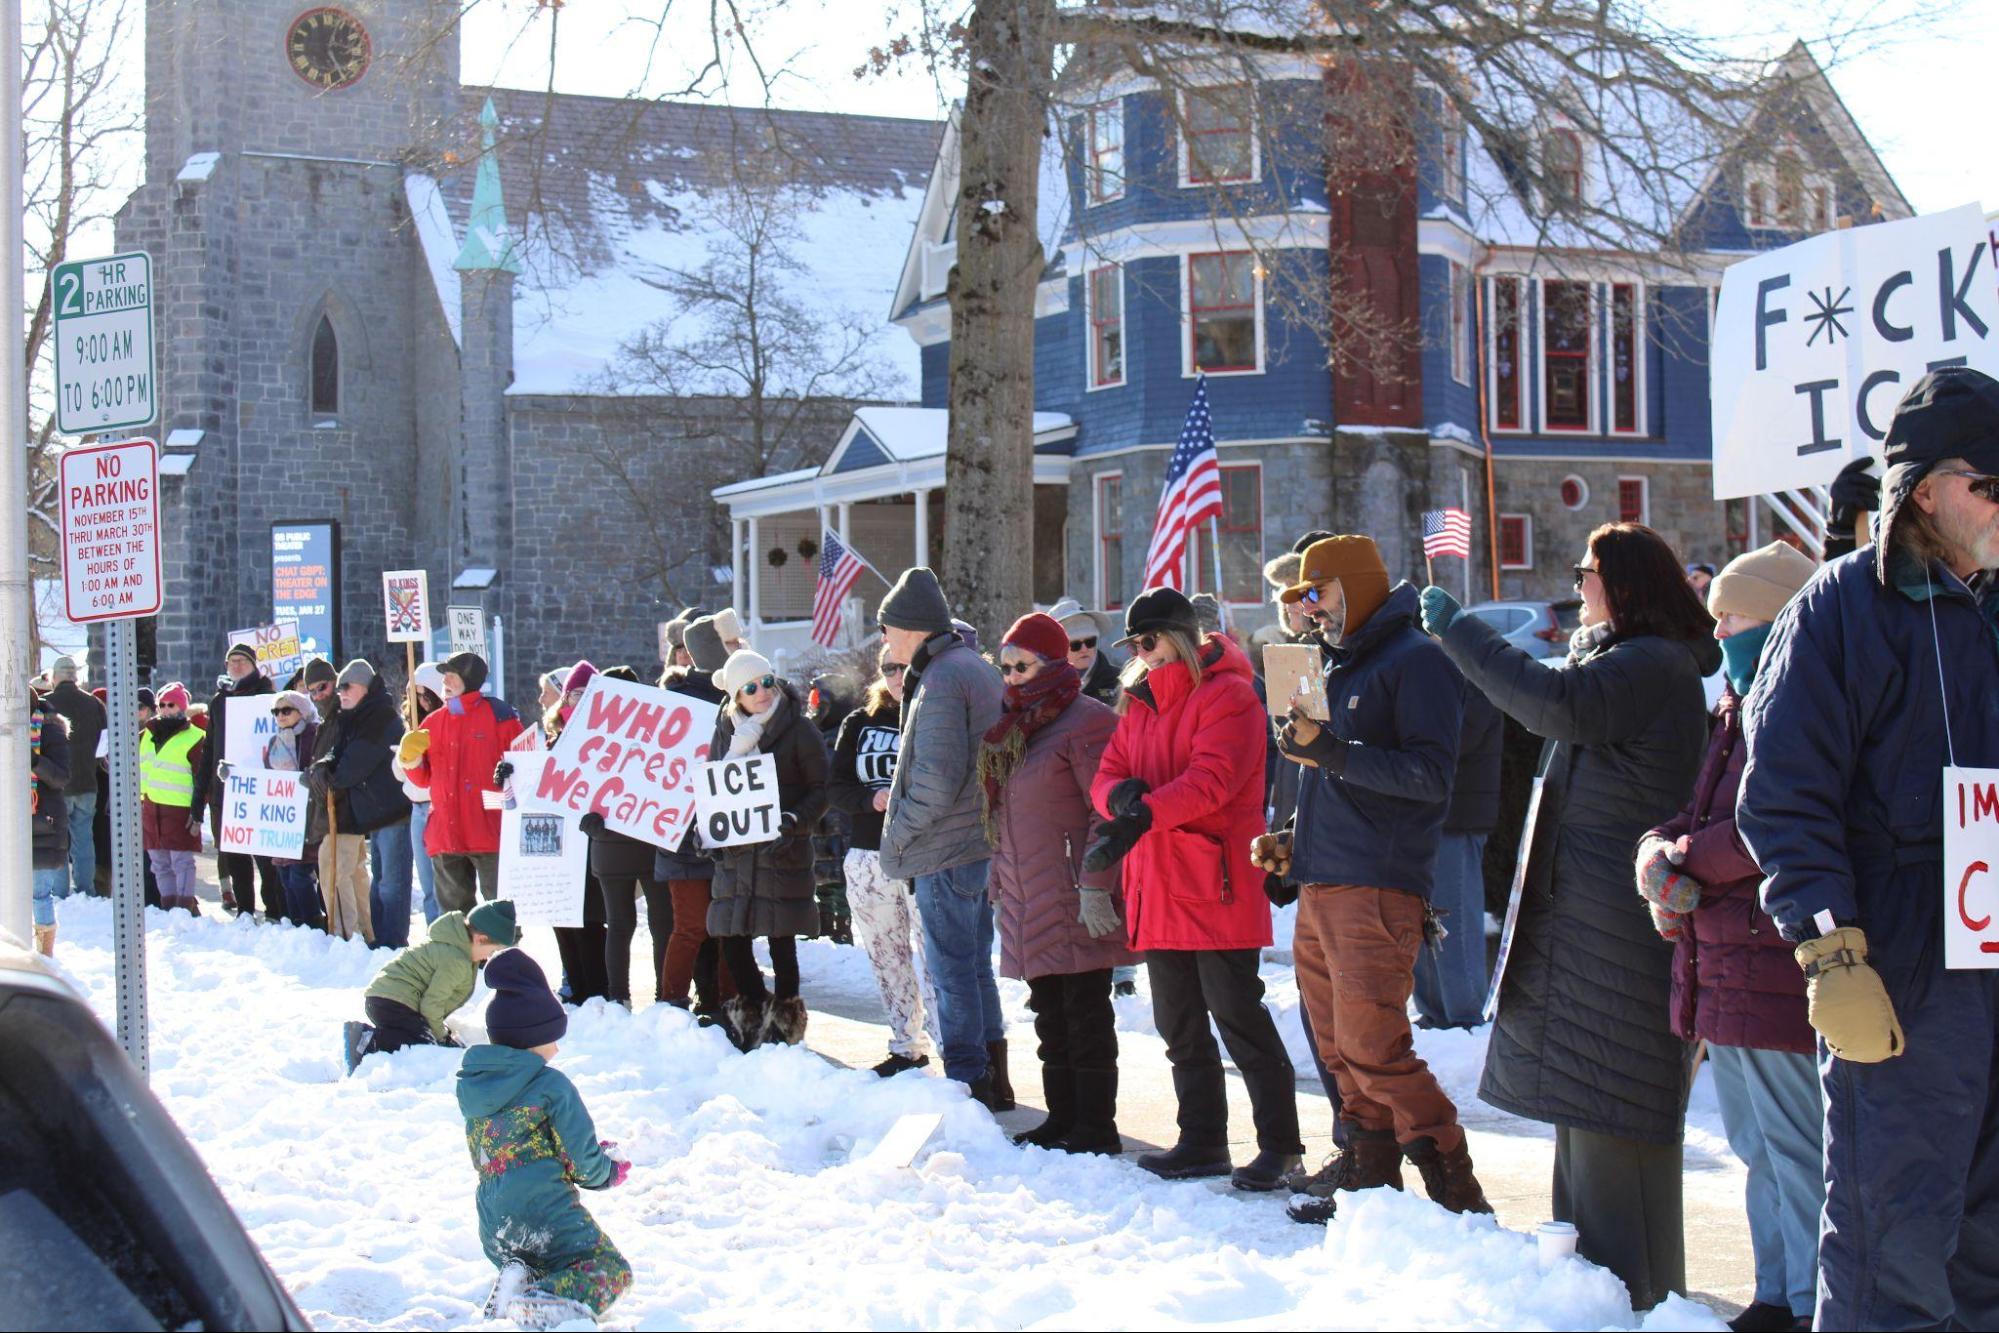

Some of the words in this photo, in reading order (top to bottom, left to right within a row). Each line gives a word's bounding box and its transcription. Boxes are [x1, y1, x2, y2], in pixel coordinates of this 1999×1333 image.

[103, 263, 125, 285] HR
[59, 273, 80, 315] 2
[86, 284, 145, 312] PARKING
[76, 333, 107, 365] 9:00
[113, 330, 133, 361] AM
[64, 382, 82, 413] TO
[92, 376, 122, 409] 6:00
[127, 373, 147, 404] PM
[1794, 355, 1968, 456] IC
[96, 455, 121, 479] NO
[71, 478, 149, 510] PARKING
[74, 509, 124, 527] NOVEMBER
[128, 506, 147, 520] 15TH
[69, 530, 92, 545] THRU
[96, 526, 128, 541] MARCH
[132, 522, 153, 536] 30TH
[78, 543, 122, 560] BETWEEN
[126, 540, 145, 554] THE
[87, 560, 119, 575] HOURS
[123, 557, 136, 571] OF
[275, 566, 297, 576] CHAT
[81, 578, 101, 593] 1:00
[104, 575, 118, 590] AM
[123, 573, 143, 587] AND
[275, 577, 312, 588] THEATER
[314, 576, 328, 587] ON
[398, 578, 419, 589] KINGS
[92, 593, 114, 608] 6:00
[118, 591, 133, 605] AM
[275, 589, 291, 599] THE
[293, 588, 317, 599] EDGE
[314, 604, 326, 615] 27
[457, 612, 476, 625] ONE
[256, 626, 281, 644] NO
[457, 629, 477, 641] WAY
[255, 638, 299, 662] CRET
[454, 643, 465, 653] DO
[469, 644, 483, 655] NOT
[259, 655, 302, 677] OLICE
[587, 690, 693, 750] WHO
[230, 775, 257, 795] THE
[267, 779, 296, 798] LAW
[706, 759, 765, 797] ICE
[234, 801, 248, 819] IS
[260, 803, 296, 823] KING
[709, 803, 775, 842] OUT
[223, 825, 254, 846] NOT
[259, 829, 304, 850] TRUMP
